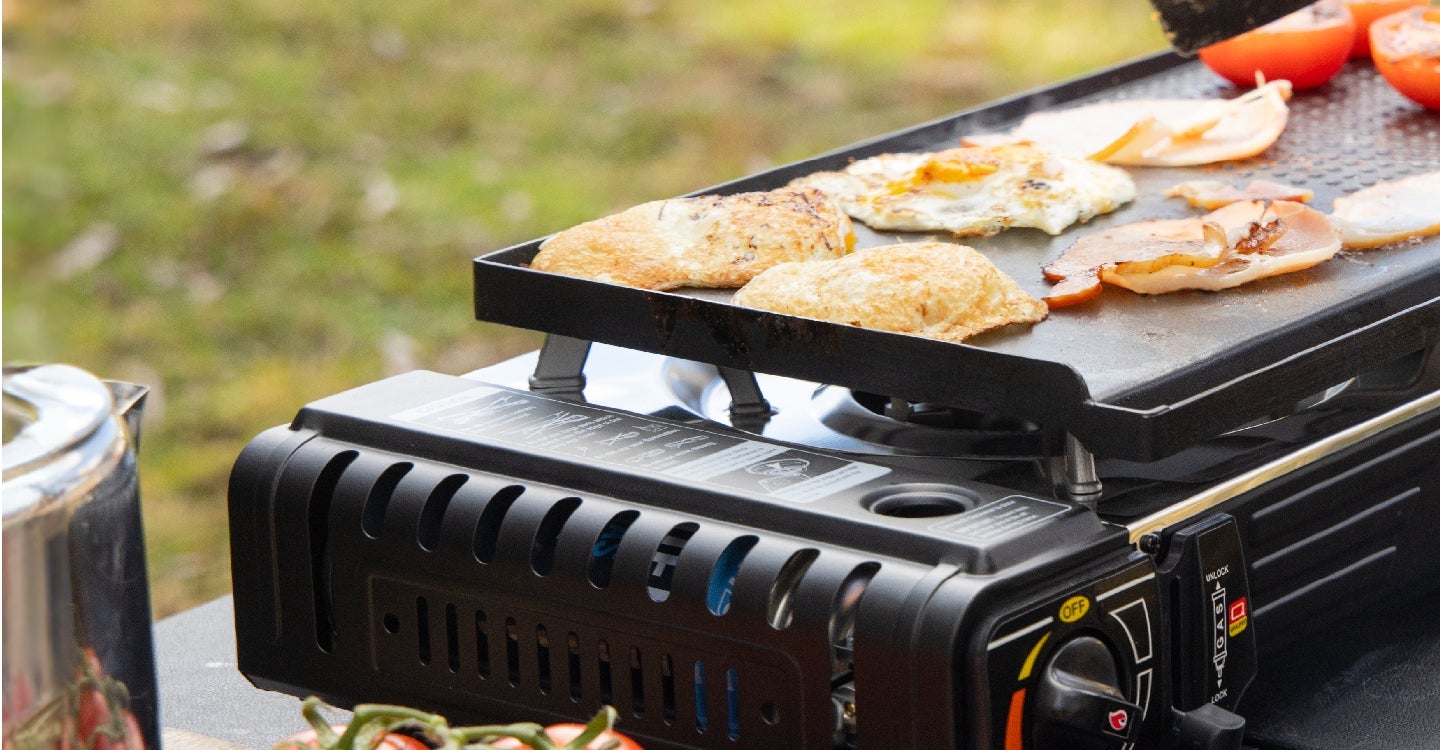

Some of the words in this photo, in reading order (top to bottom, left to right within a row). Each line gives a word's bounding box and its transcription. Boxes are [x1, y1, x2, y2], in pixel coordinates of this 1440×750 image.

[1206, 565, 1229, 582] UNLOCK
[1063, 601, 1087, 620] OFF
[1211, 689, 1228, 704] LOCK
